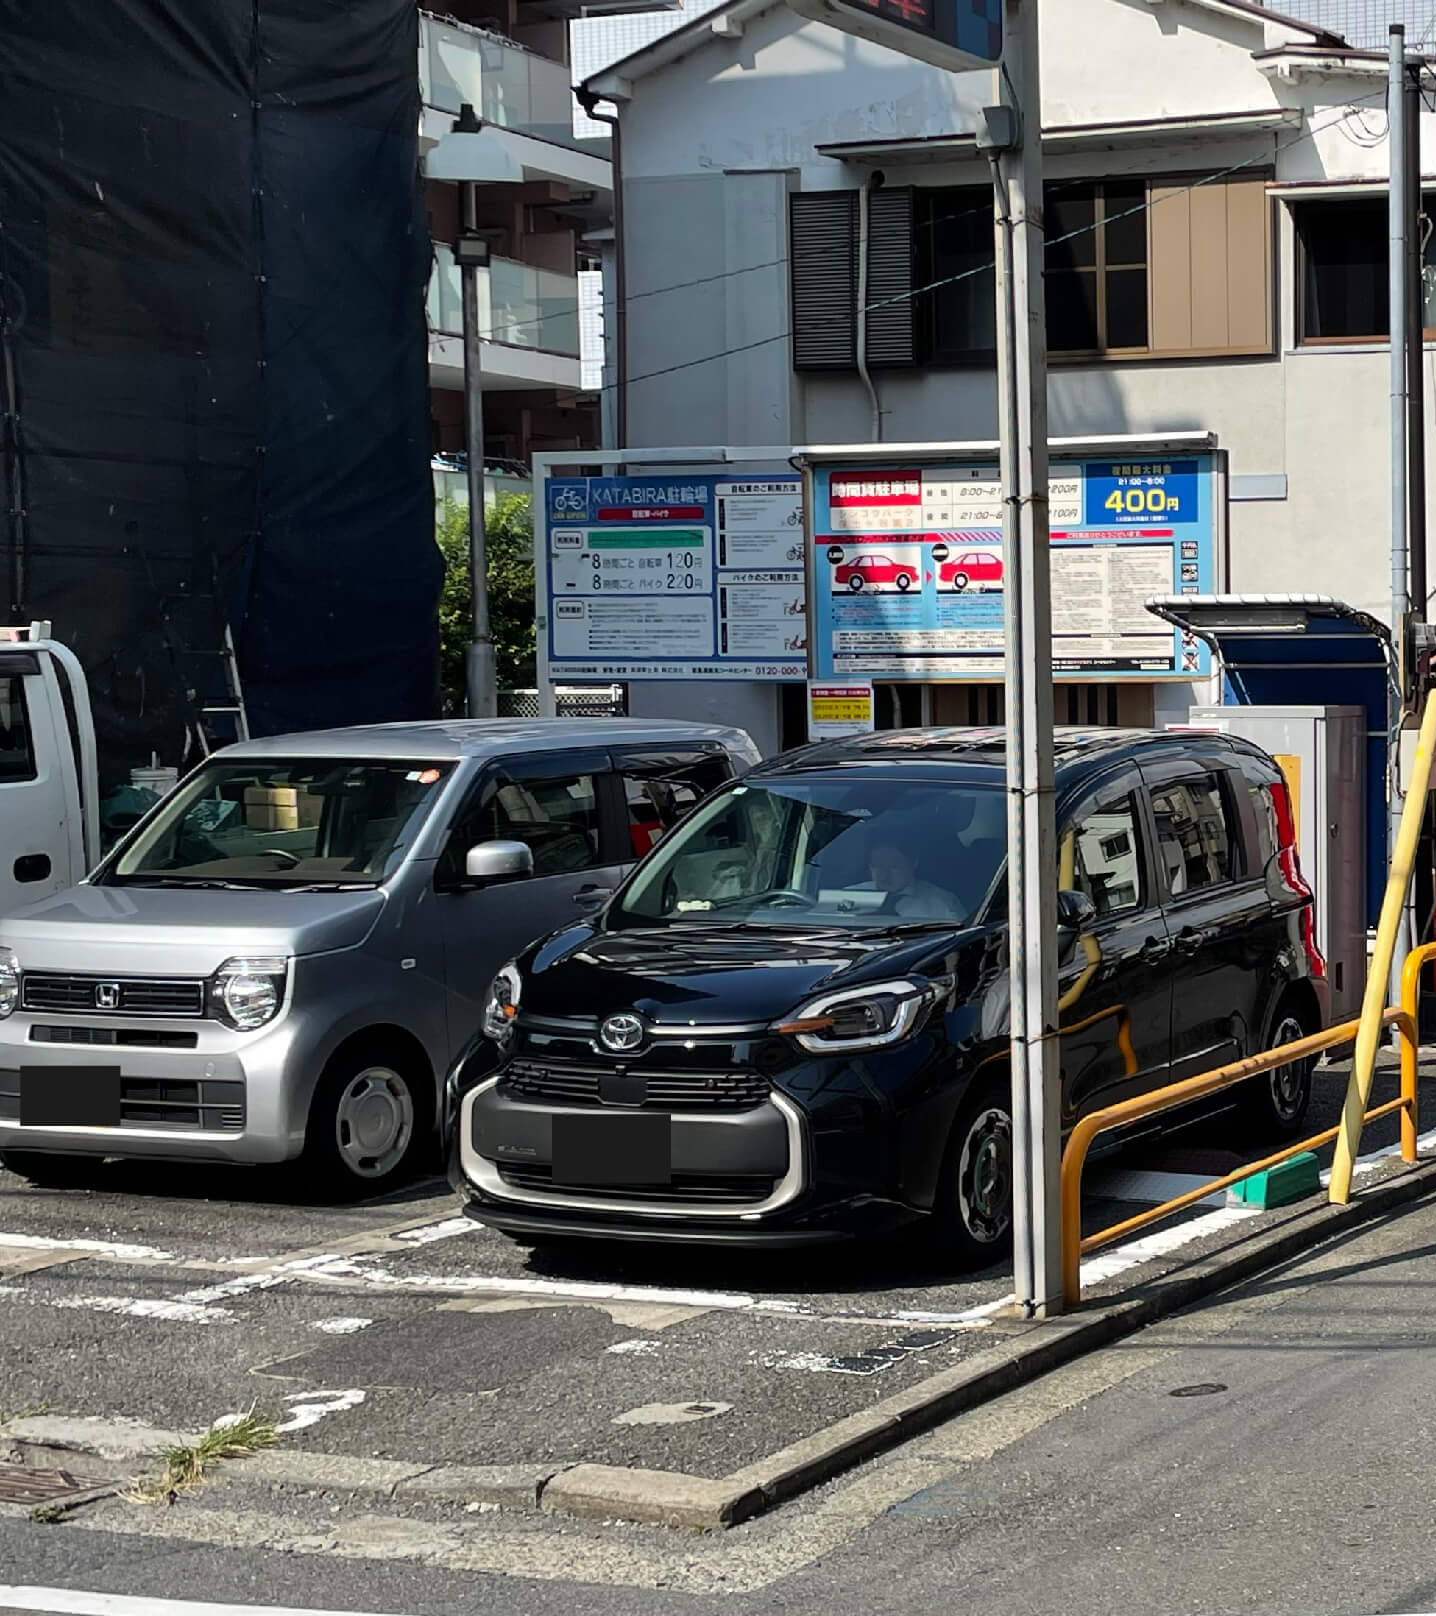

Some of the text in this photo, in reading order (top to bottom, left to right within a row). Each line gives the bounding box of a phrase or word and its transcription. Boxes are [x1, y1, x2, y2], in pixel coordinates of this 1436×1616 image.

[831, 481, 919, 497] 時間貸駐車場
[1105, 488, 1179, 513] 400円
